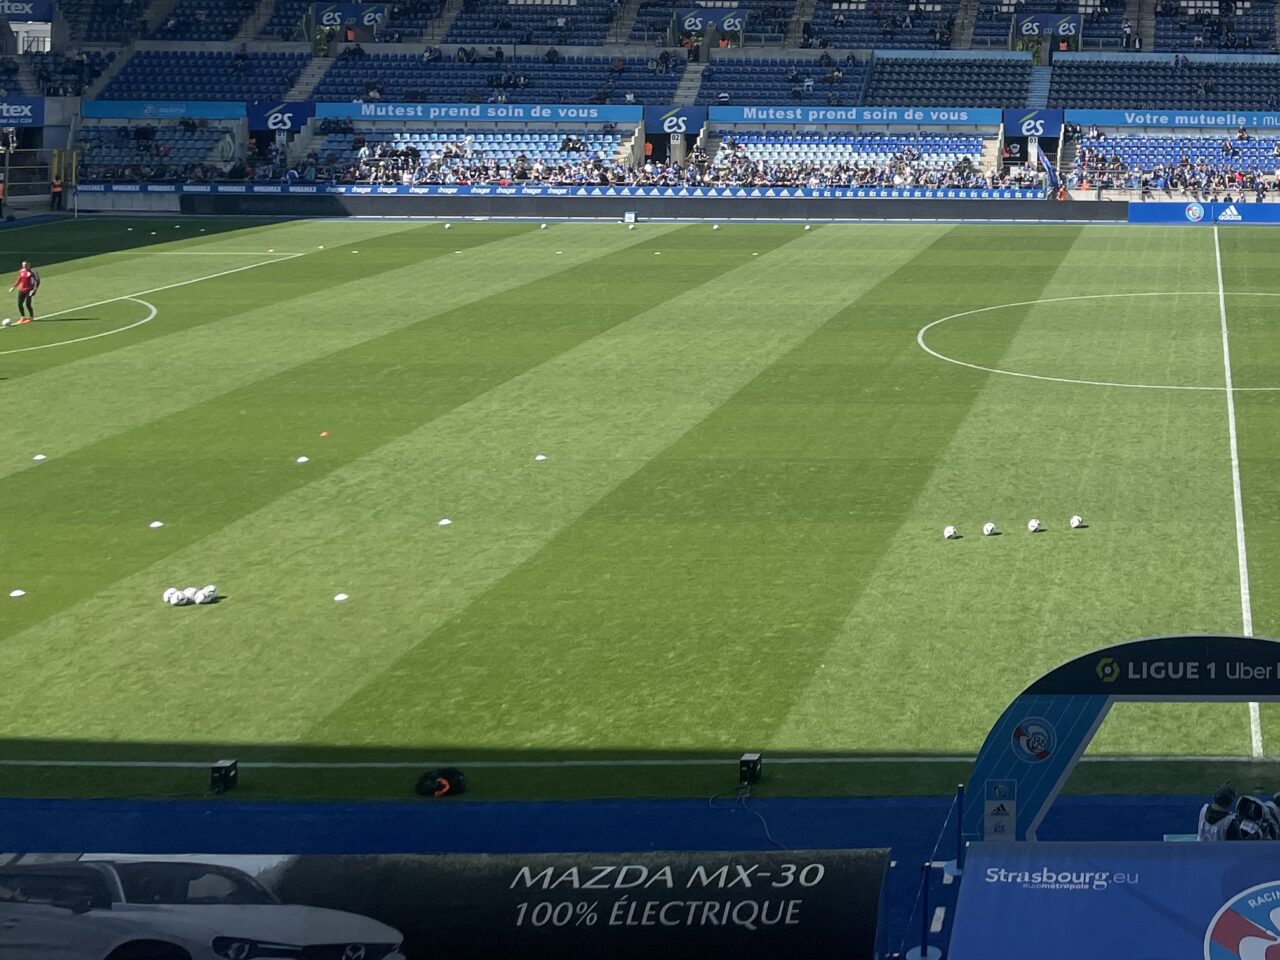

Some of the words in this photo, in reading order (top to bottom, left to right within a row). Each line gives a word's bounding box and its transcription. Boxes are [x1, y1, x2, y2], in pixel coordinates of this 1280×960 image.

[0, 0, 33, 14] tex
[0, 102, 32, 117] tex
[361, 104, 422, 117] Mutest
[429, 105, 480, 121] prend
[487, 105, 524, 117] soin
[531, 105, 551, 117] de
[558, 108, 598, 118] vous
[743, 108, 801, 120] Mutest
[808, 108, 856, 124] prend
[863, 108, 898, 120] soin
[904, 108, 923, 121] de
[930, 111, 968, 121] vous
[1125, 113, 1171, 125] Votre
[1175, 114, 1246, 127] mutuelle
[1128, 661, 1199, 680] LIGUE
[1206, 661, 1216, 679] 1
[1226, 662, 1272, 680] Uber
[509, 865, 674, 889] MAZDA
[686, 863, 825, 888] MX-30
[515, 901, 598, 926] 100%
[608, 895, 802, 930] ÉLECTRIQUE
